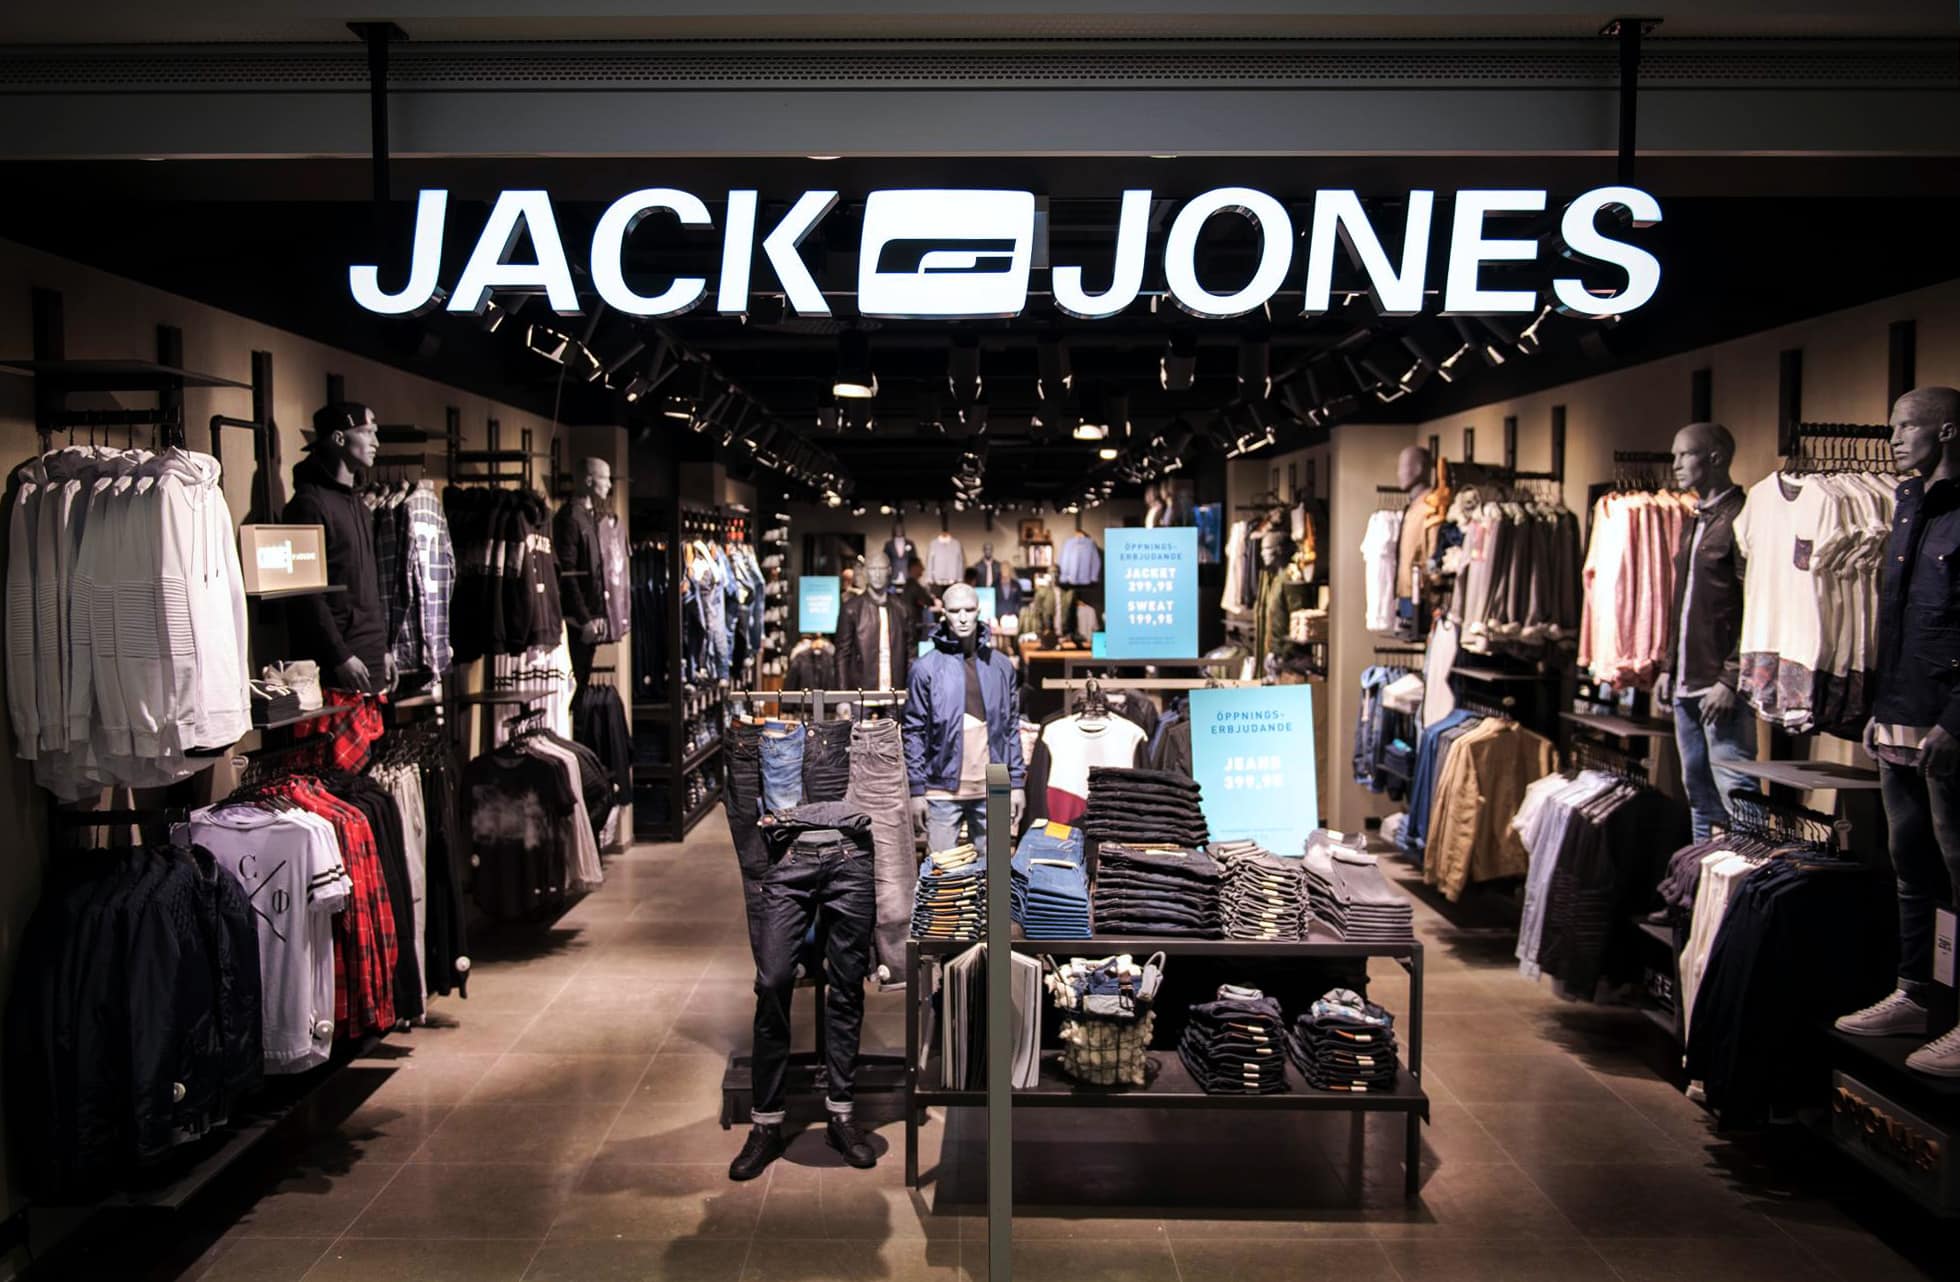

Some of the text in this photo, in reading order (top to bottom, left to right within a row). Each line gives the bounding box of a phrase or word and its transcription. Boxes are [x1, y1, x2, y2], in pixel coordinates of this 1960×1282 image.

[349, 186, 1664, 317] JACK JONES
[1124, 567, 1177, 580] JACKET
[1127, 599, 1175, 613] SWEAT
[1128, 613, 1174, 627] 199,95
[1216, 709, 1286, 722] ÖPPNINGS-
[1210, 722, 1293, 735] ERBJUDANDE
